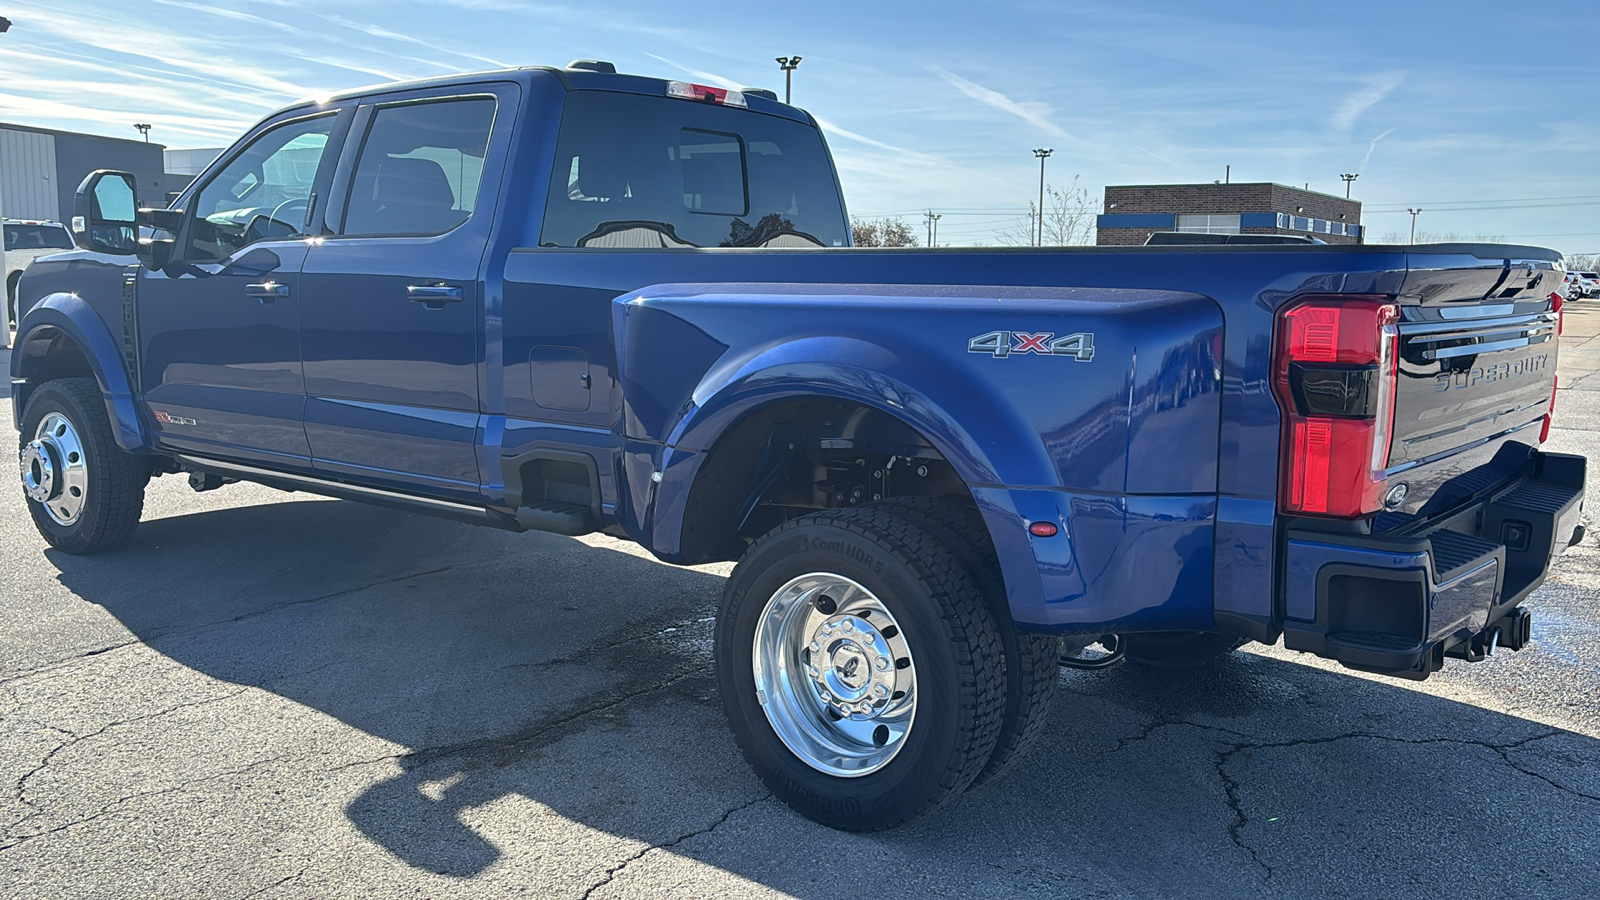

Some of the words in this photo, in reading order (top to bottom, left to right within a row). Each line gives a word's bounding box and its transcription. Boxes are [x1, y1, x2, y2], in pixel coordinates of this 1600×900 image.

[1433, 362, 1510, 394] SUPER
[1514, 354, 1548, 377] DUTY
[812, 537, 845, 554] Conti
[847, 543, 874, 568] HDR
[874, 560, 884, 573] 5
